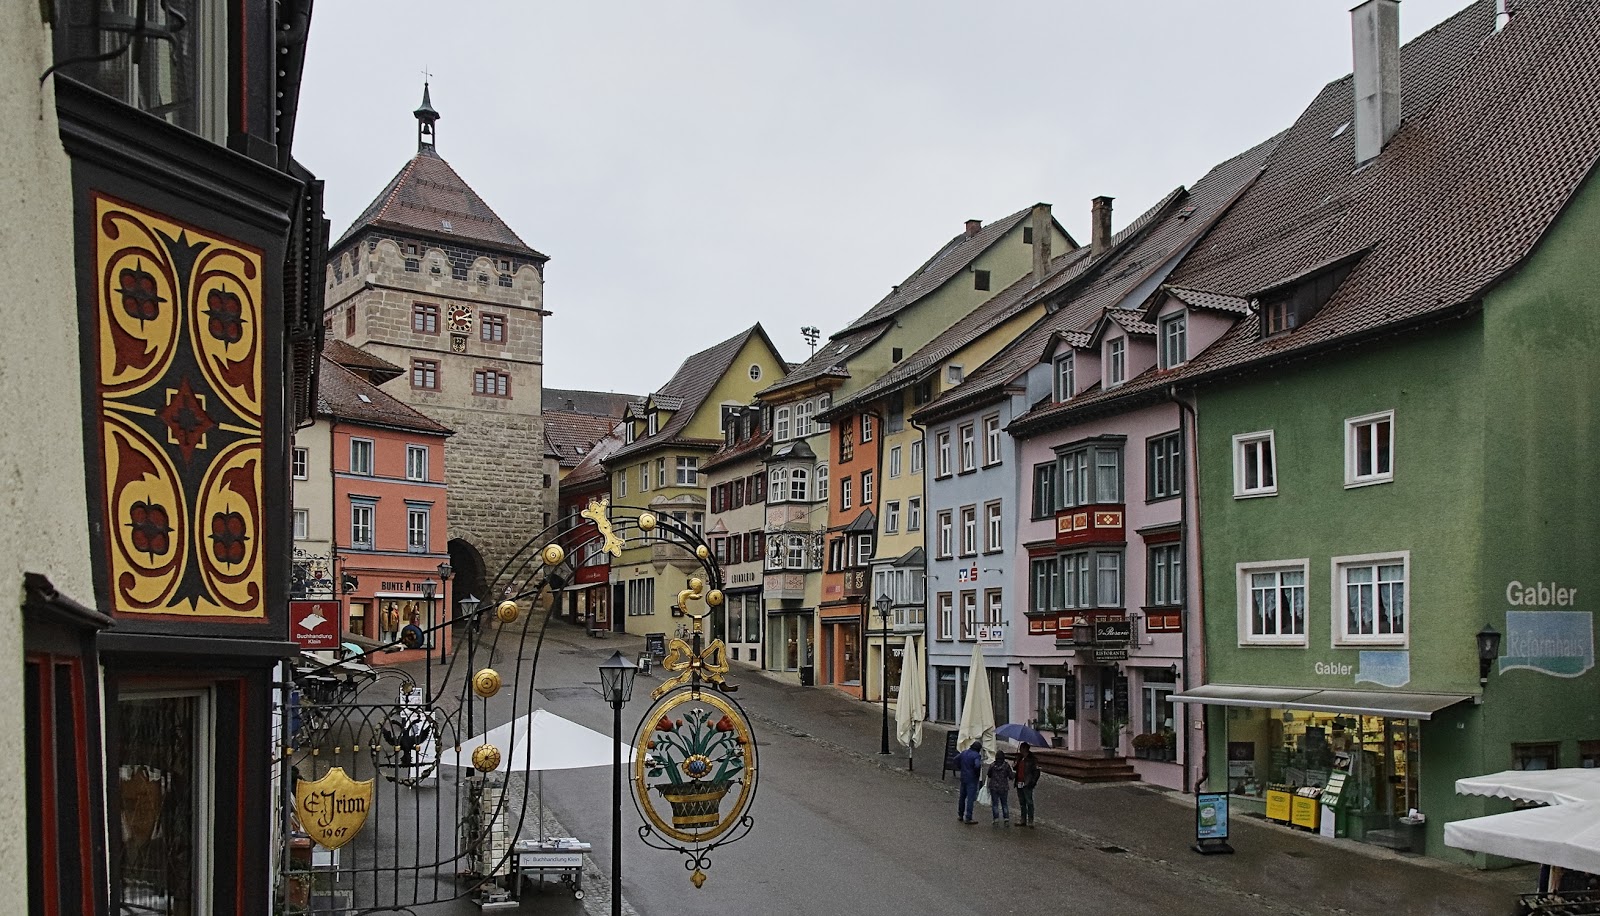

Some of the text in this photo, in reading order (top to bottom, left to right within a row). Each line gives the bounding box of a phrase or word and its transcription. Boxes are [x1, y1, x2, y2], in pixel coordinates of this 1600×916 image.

[381, 581, 404, 591] BUNTE
[1506, 580, 1577, 606] Gabler
[1314, 661, 1353, 675] Gabler
[319, 827, 348, 839] 1967
